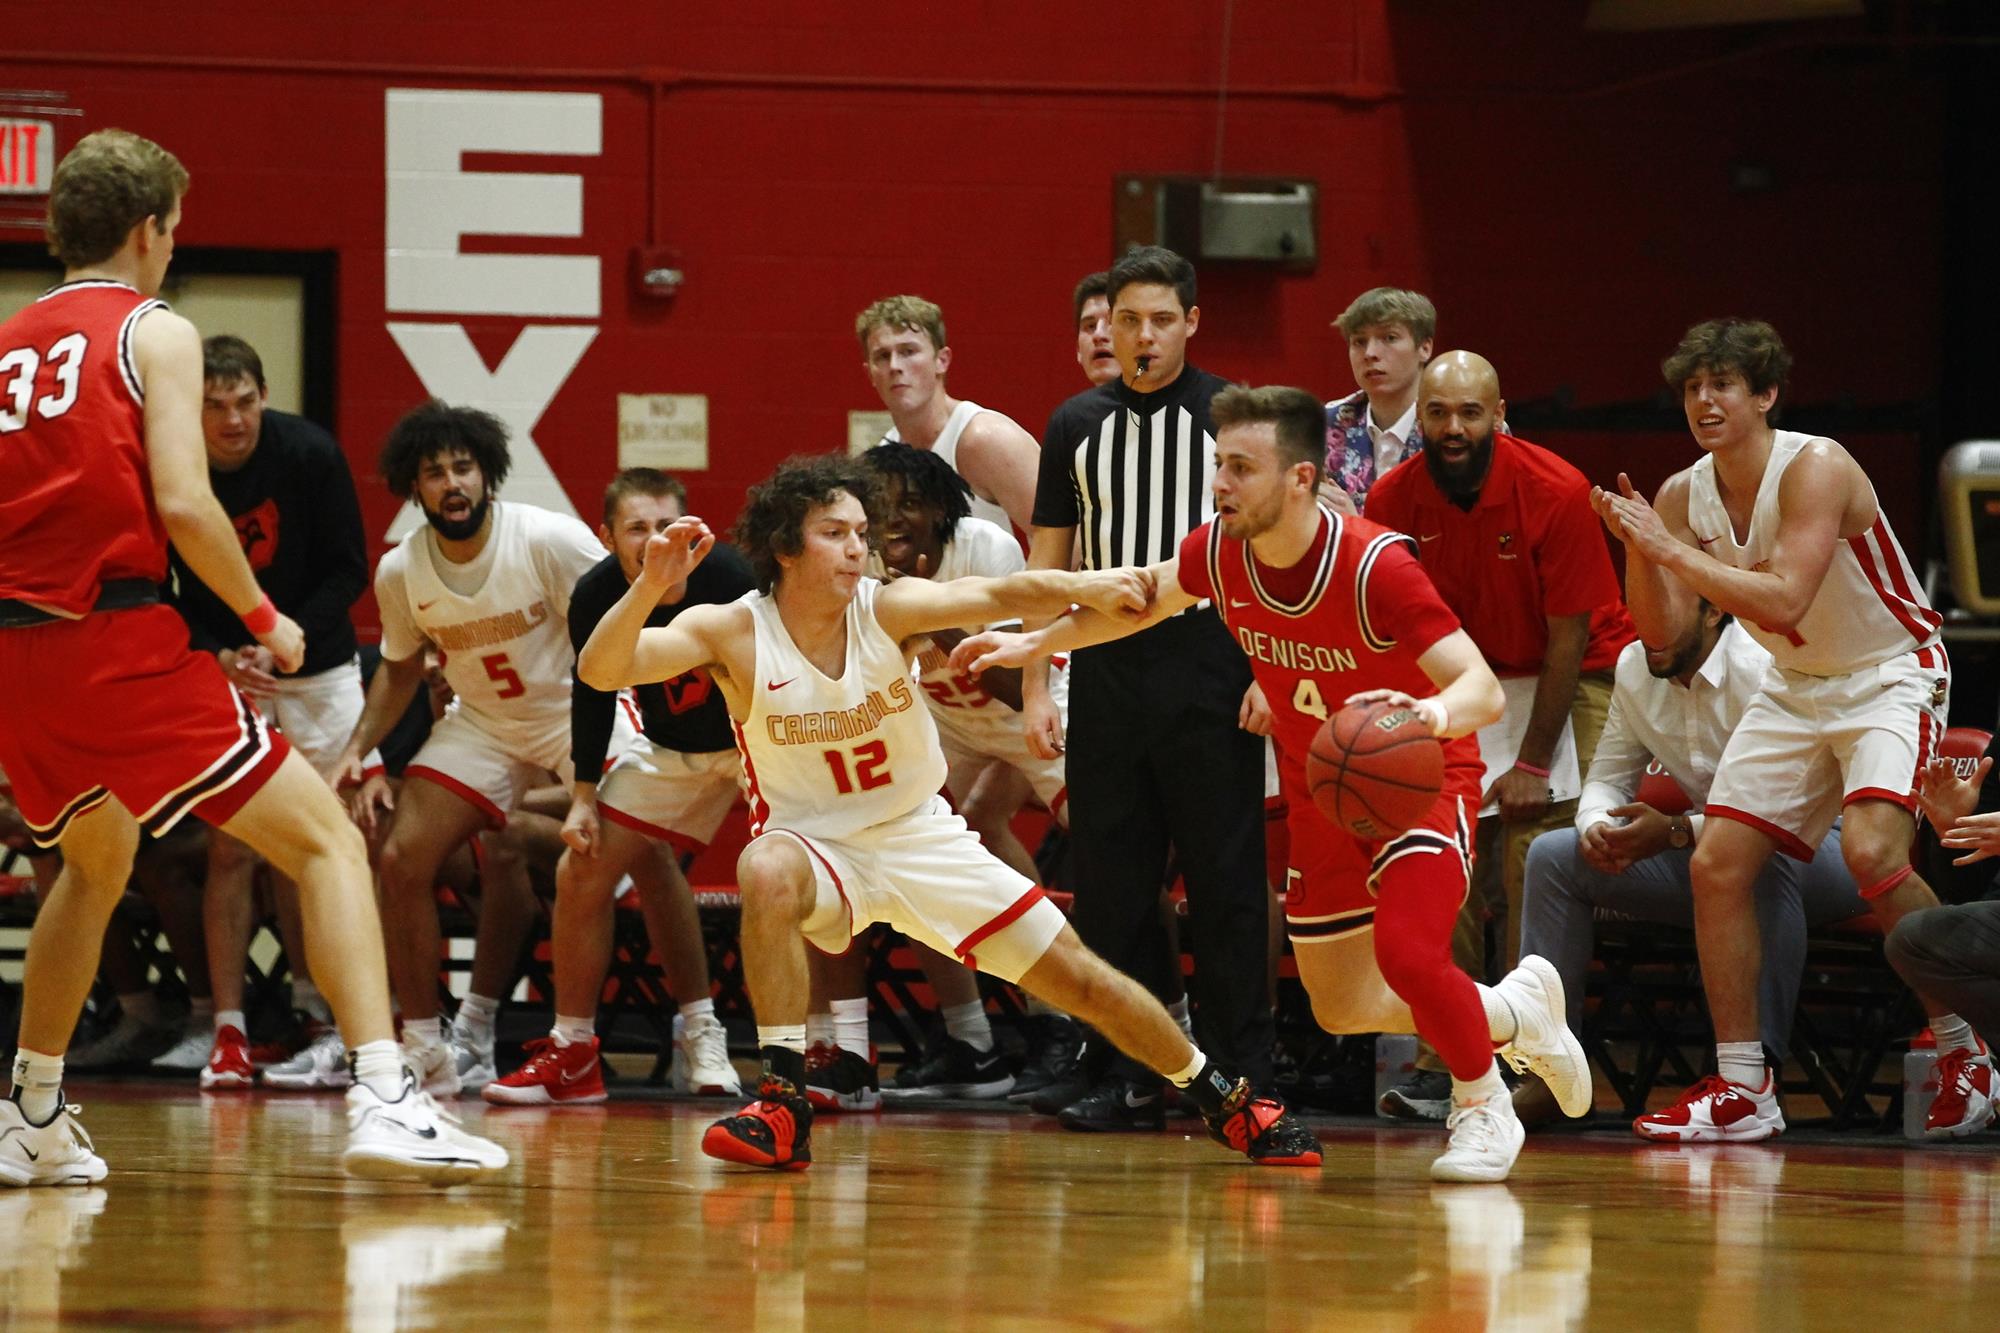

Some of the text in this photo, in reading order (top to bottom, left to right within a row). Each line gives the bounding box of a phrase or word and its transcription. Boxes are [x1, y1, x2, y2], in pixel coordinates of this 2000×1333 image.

[0, 331, 89, 433] 33
[1238, 626, 1358, 672] DENISON
[481, 652, 527, 700] 5
[920, 673, 994, 709] 25
[1292, 678, 1328, 722] 4
[766, 677, 914, 746] CARDINALS
[823, 739, 893, 795] 12
